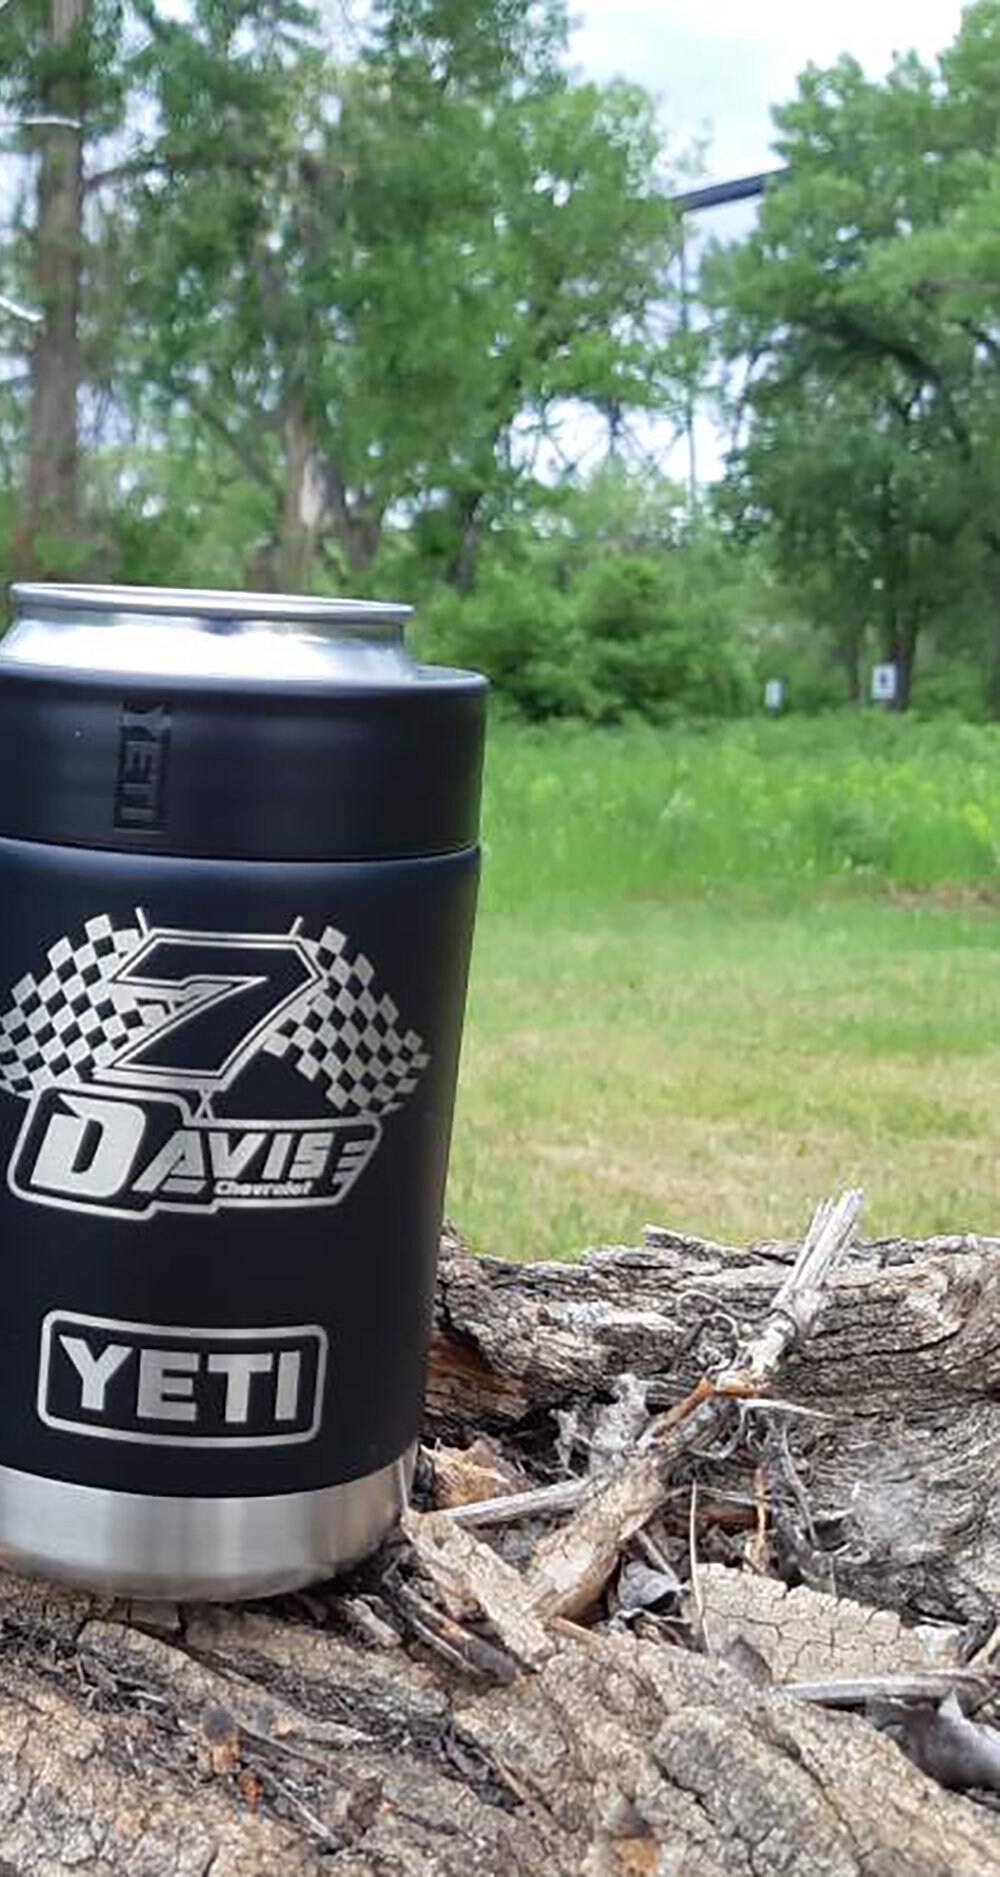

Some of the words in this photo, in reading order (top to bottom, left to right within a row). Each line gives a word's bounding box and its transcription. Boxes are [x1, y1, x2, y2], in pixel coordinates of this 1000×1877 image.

[120, 703, 169, 822] YETI
[96, 928, 324, 1092] 7
[30, 1093, 335, 1198] DAVIS
[58, 1334, 300, 1423] YETI
